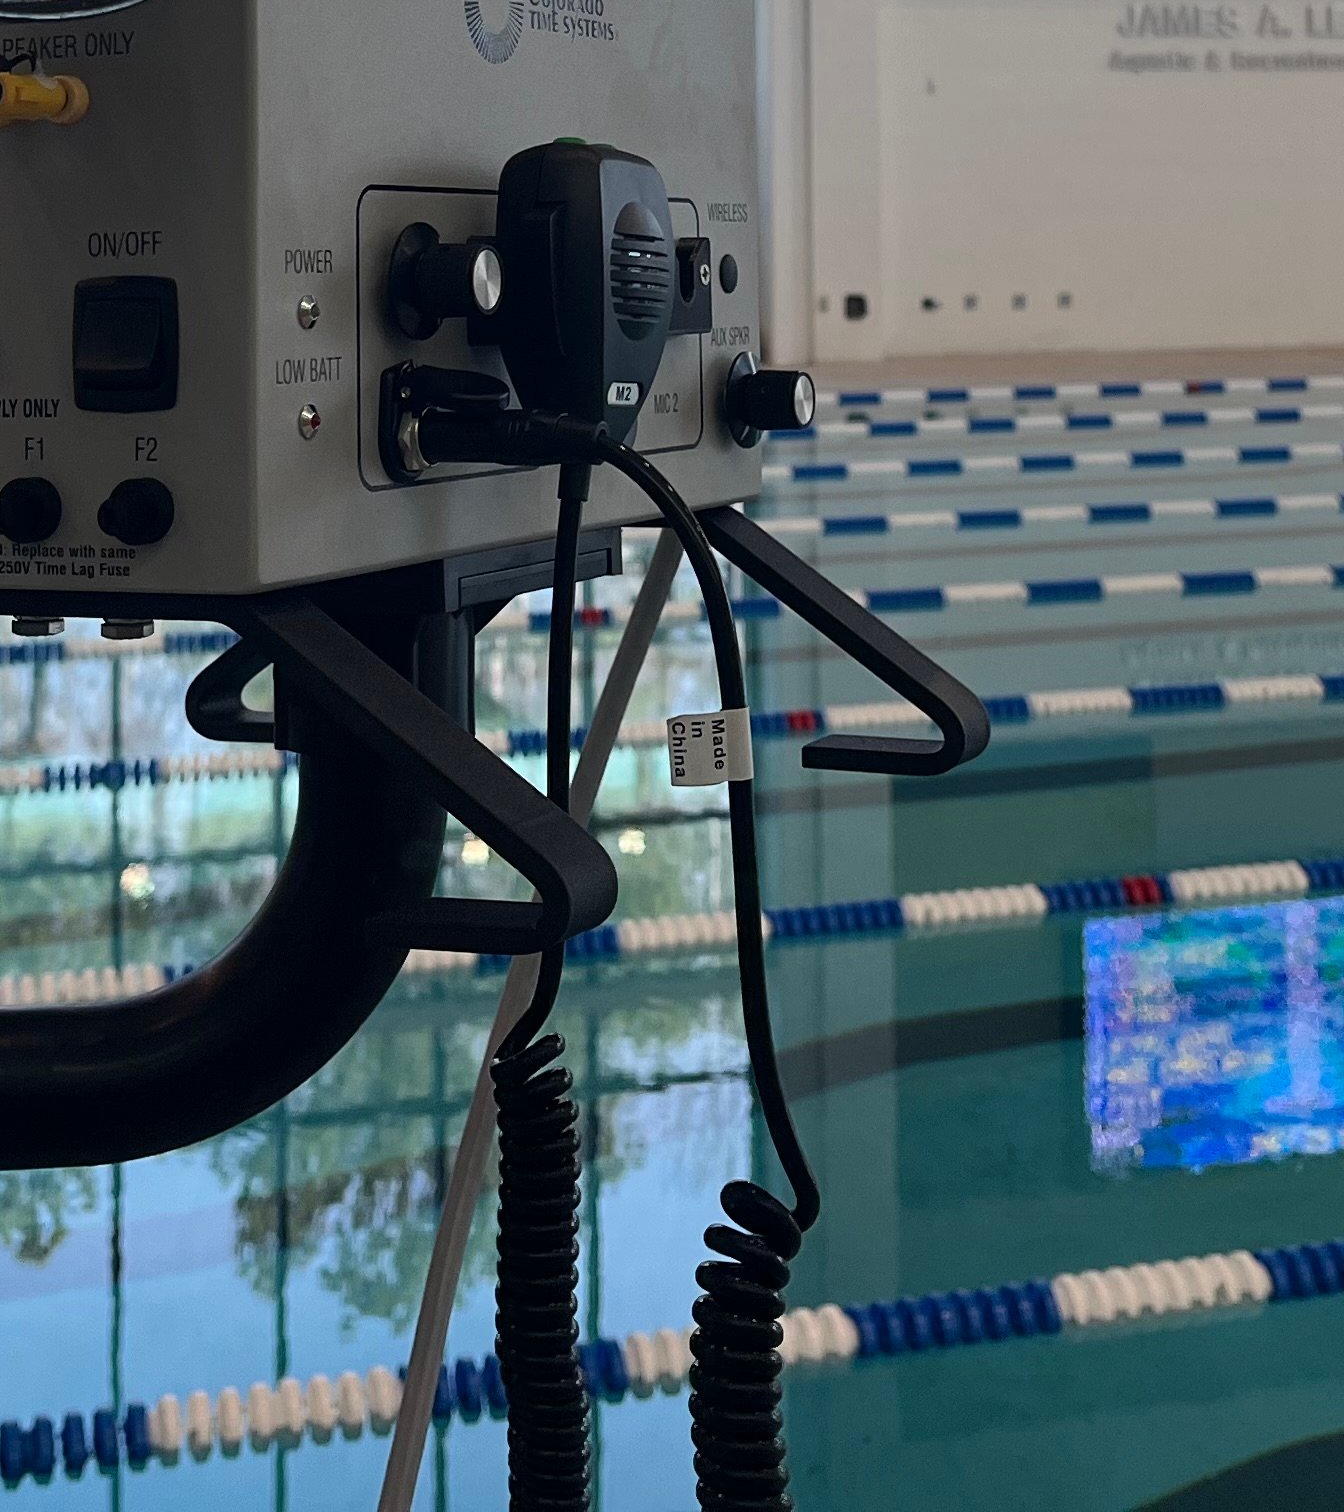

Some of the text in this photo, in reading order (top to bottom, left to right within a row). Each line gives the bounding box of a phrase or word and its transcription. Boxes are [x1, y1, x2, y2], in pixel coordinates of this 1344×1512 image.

[529, 9, 614, 43] TIME SYSTEMS
[1116, 4, 1240, 39] JAMES
[84, 31, 135, 57] ONLY
[706, 202, 748, 223] WIRELESS
[88, 230, 163, 259] ON/OFF
[284, 249, 333, 274] POWER
[276, 356, 342, 385] LOW BATT
[616, 386, 632, 401] M2
[672, 392, 679, 412] 2
[23, 398, 60, 418] ONLY
[24, 437, 44, 461] F1
[135, 436, 158, 462] F2
[12, 543, 64, 560] Replace
[69, 544, 96, 559] with
[100, 547, 136, 559] same
[34, 561, 66, 576] Time
[71, 562, 95, 579] Lag
[99, 562, 130, 576] Fuse
[691, 721, 705, 738] in
[671, 721, 687, 778] China
[711, 718, 726, 770] Made
